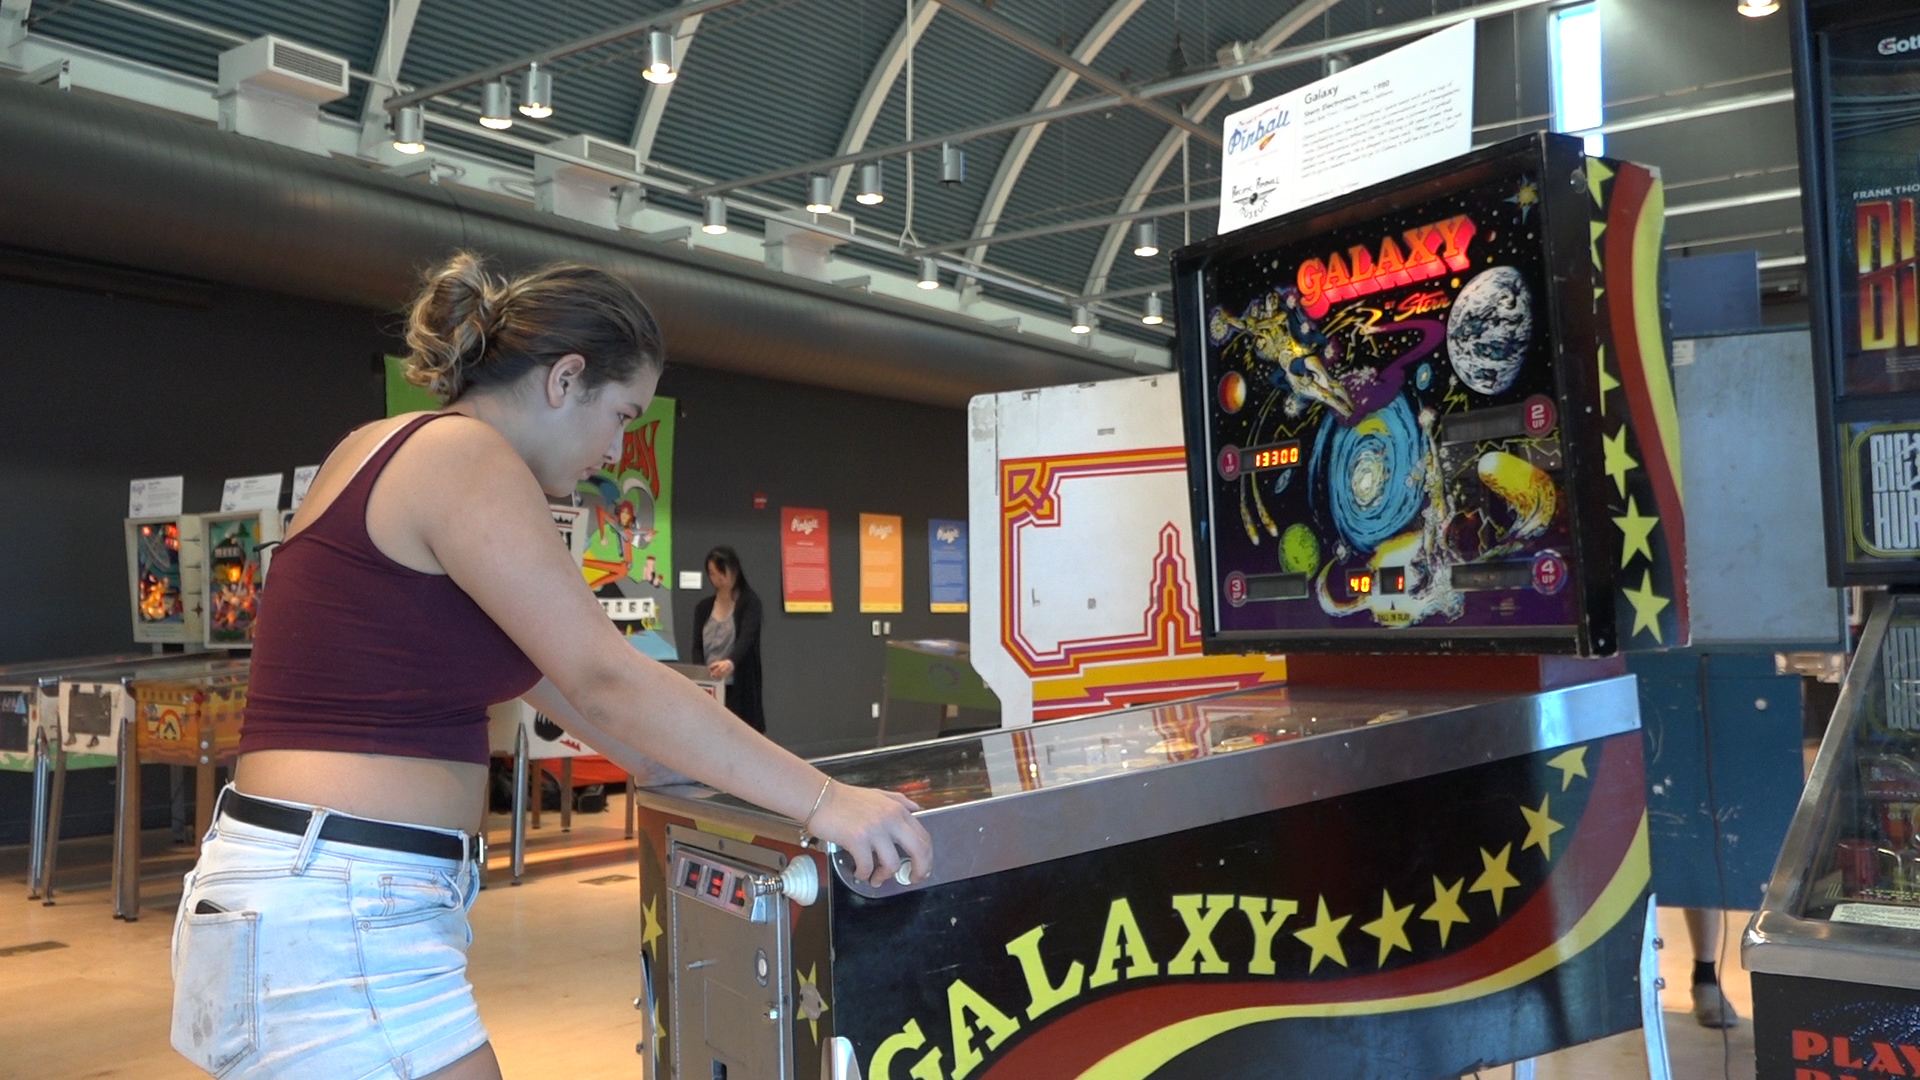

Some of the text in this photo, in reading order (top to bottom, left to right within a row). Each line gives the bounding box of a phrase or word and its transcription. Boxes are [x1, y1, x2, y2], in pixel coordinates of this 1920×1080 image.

[1304, 85, 1339, 105] Galaxy
[1228, 110, 1291, 155] Pinball
[1852, 187, 1893, 200] FRANK
[1297, 214, 1476, 318] GALAXY
[1393, 290, 1452, 322] Stern
[1531, 404, 1545, 419] 2
[1532, 419, 1545, 429] UP
[1226, 453, 1233, 465] 1
[1255, 447, 1299, 468] 13300
[1541, 560, 1555, 575] 4
[1231, 579, 1242, 592] 3
[1350, 576, 1371, 593] 40
[1397, 576, 1404, 591] 1
[1541, 574, 1555, 584] UP
[868, 893, 1299, 1080] GALAXY
